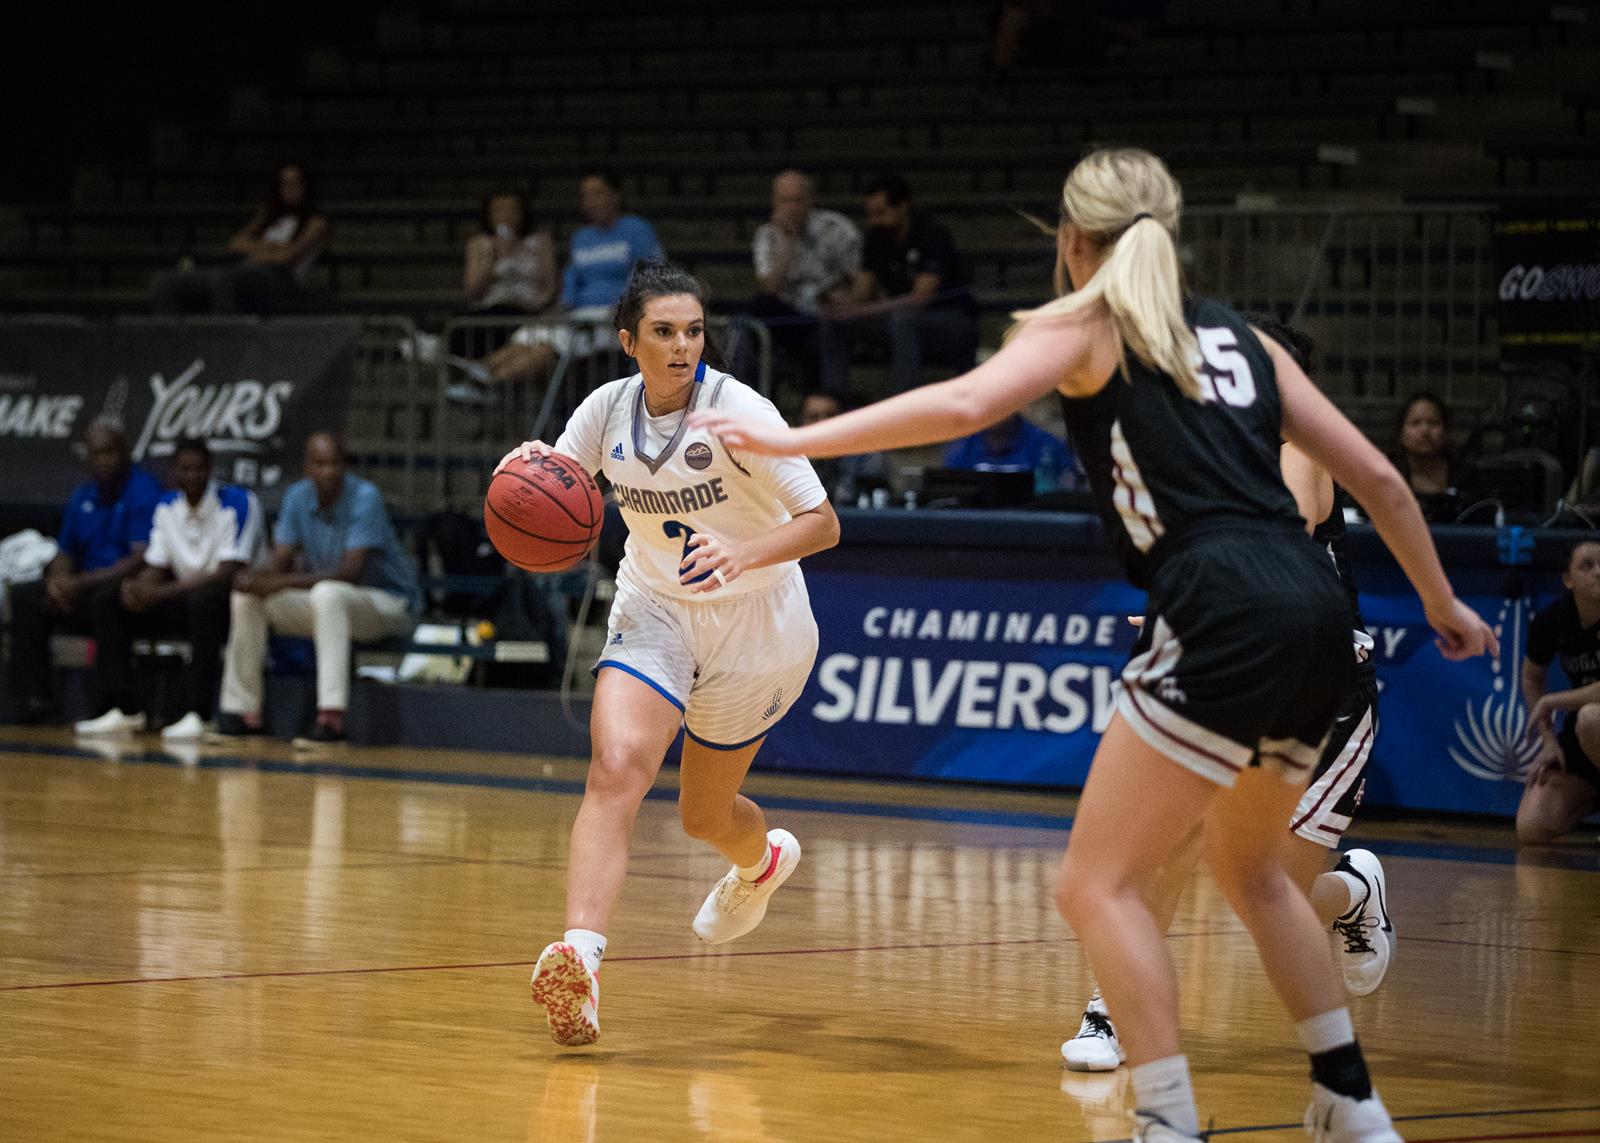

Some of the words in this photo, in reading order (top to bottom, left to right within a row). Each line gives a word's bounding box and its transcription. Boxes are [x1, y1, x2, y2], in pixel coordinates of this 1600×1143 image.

[1196, 326, 1257, 408] 5
[613, 476, 729, 515] CHAMINADE
[863, 606, 1118, 646] CHAMINADE
